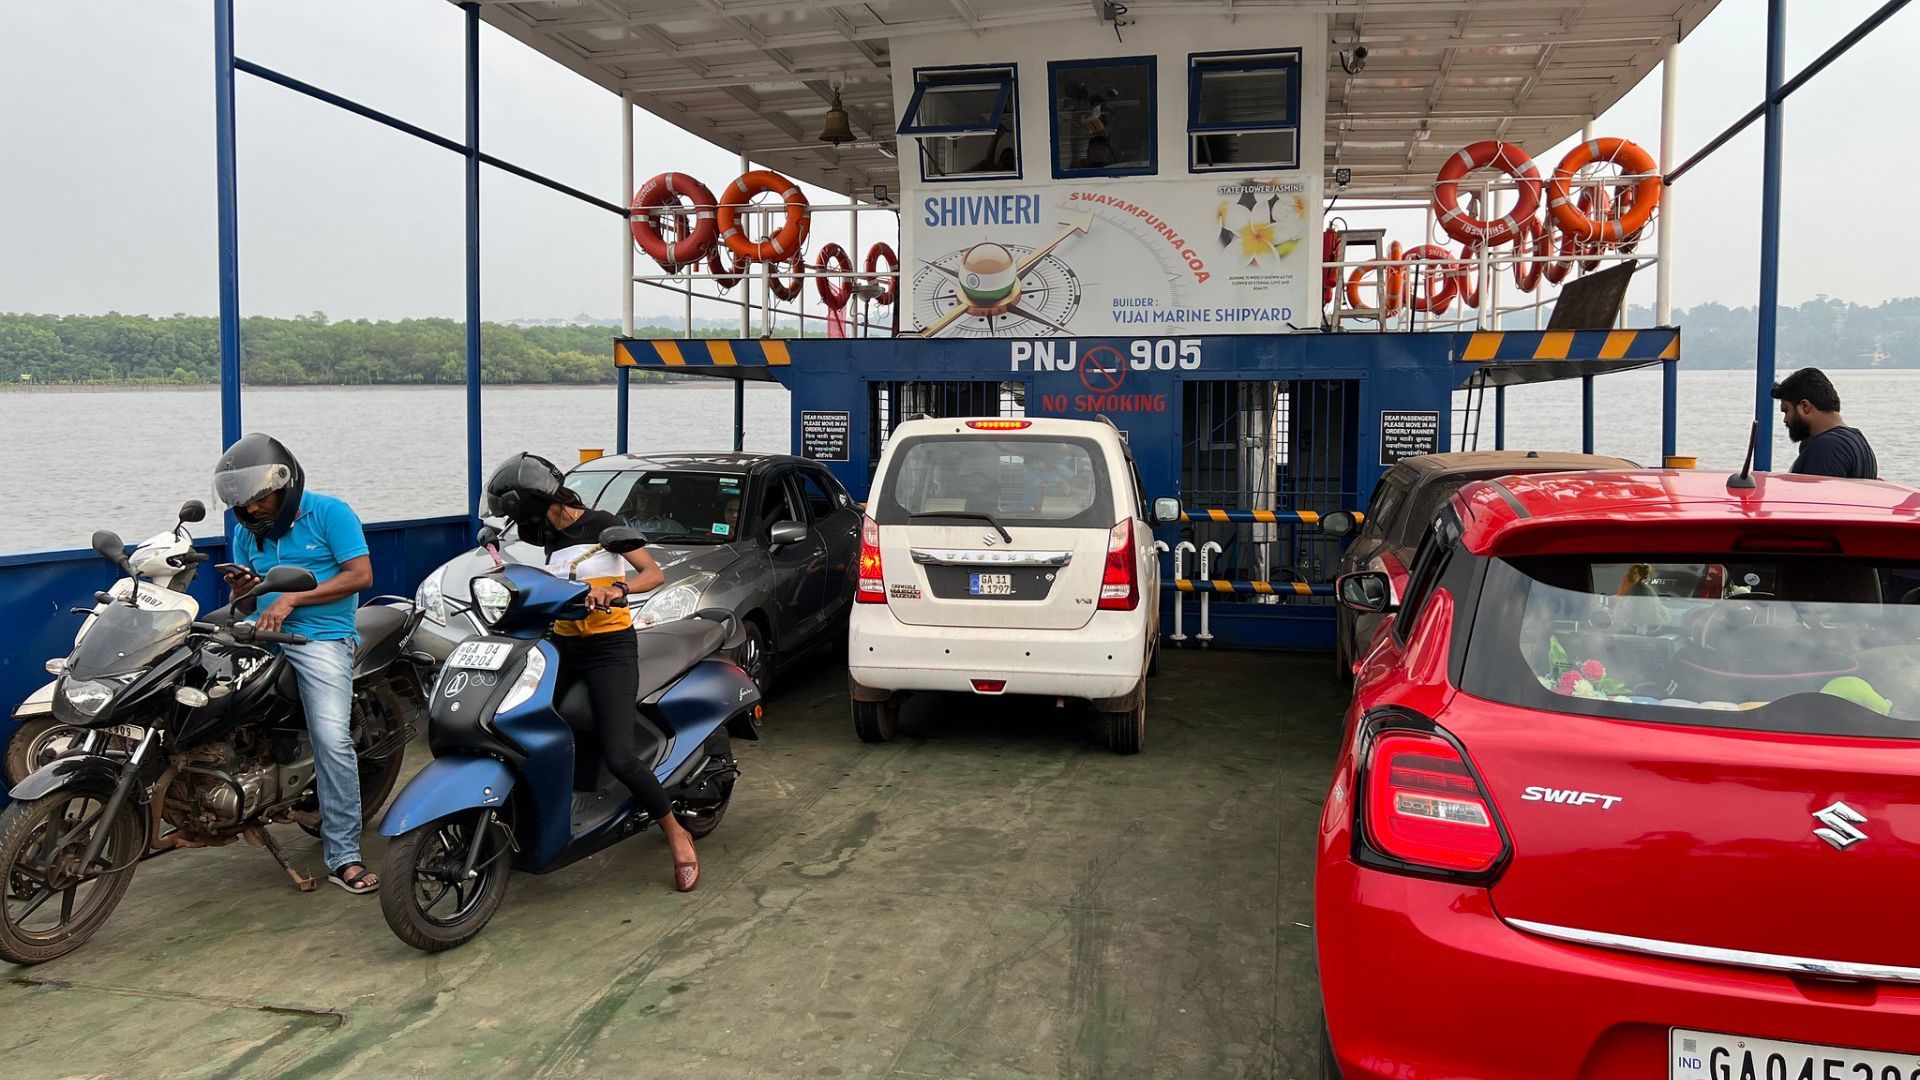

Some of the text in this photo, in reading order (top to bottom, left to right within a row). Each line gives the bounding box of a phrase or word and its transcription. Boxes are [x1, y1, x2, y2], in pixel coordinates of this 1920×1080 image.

[1241, 185, 1270, 193] FLOWER
[1272, 184, 1304, 192] JASMINE
[924, 194, 1040, 227] SHIVNERI
[1069, 192, 1211, 284] SWAYAMPURNA GOA
[1112, 307, 1292, 324] VIJAI MARINE SHIPYARD
[1010, 338, 1202, 372] PNJ 905
[1042, 393, 1167, 413] NO SMOKING
[981, 575, 1007, 584] GA 11
[987, 585, 1010, 594] 1797
[466, 643, 500, 655] GA 04
[457, 654, 493, 667] P8204
[1521, 786, 1622, 809] SWIFT
[1678, 1056, 1702, 1070] IND
